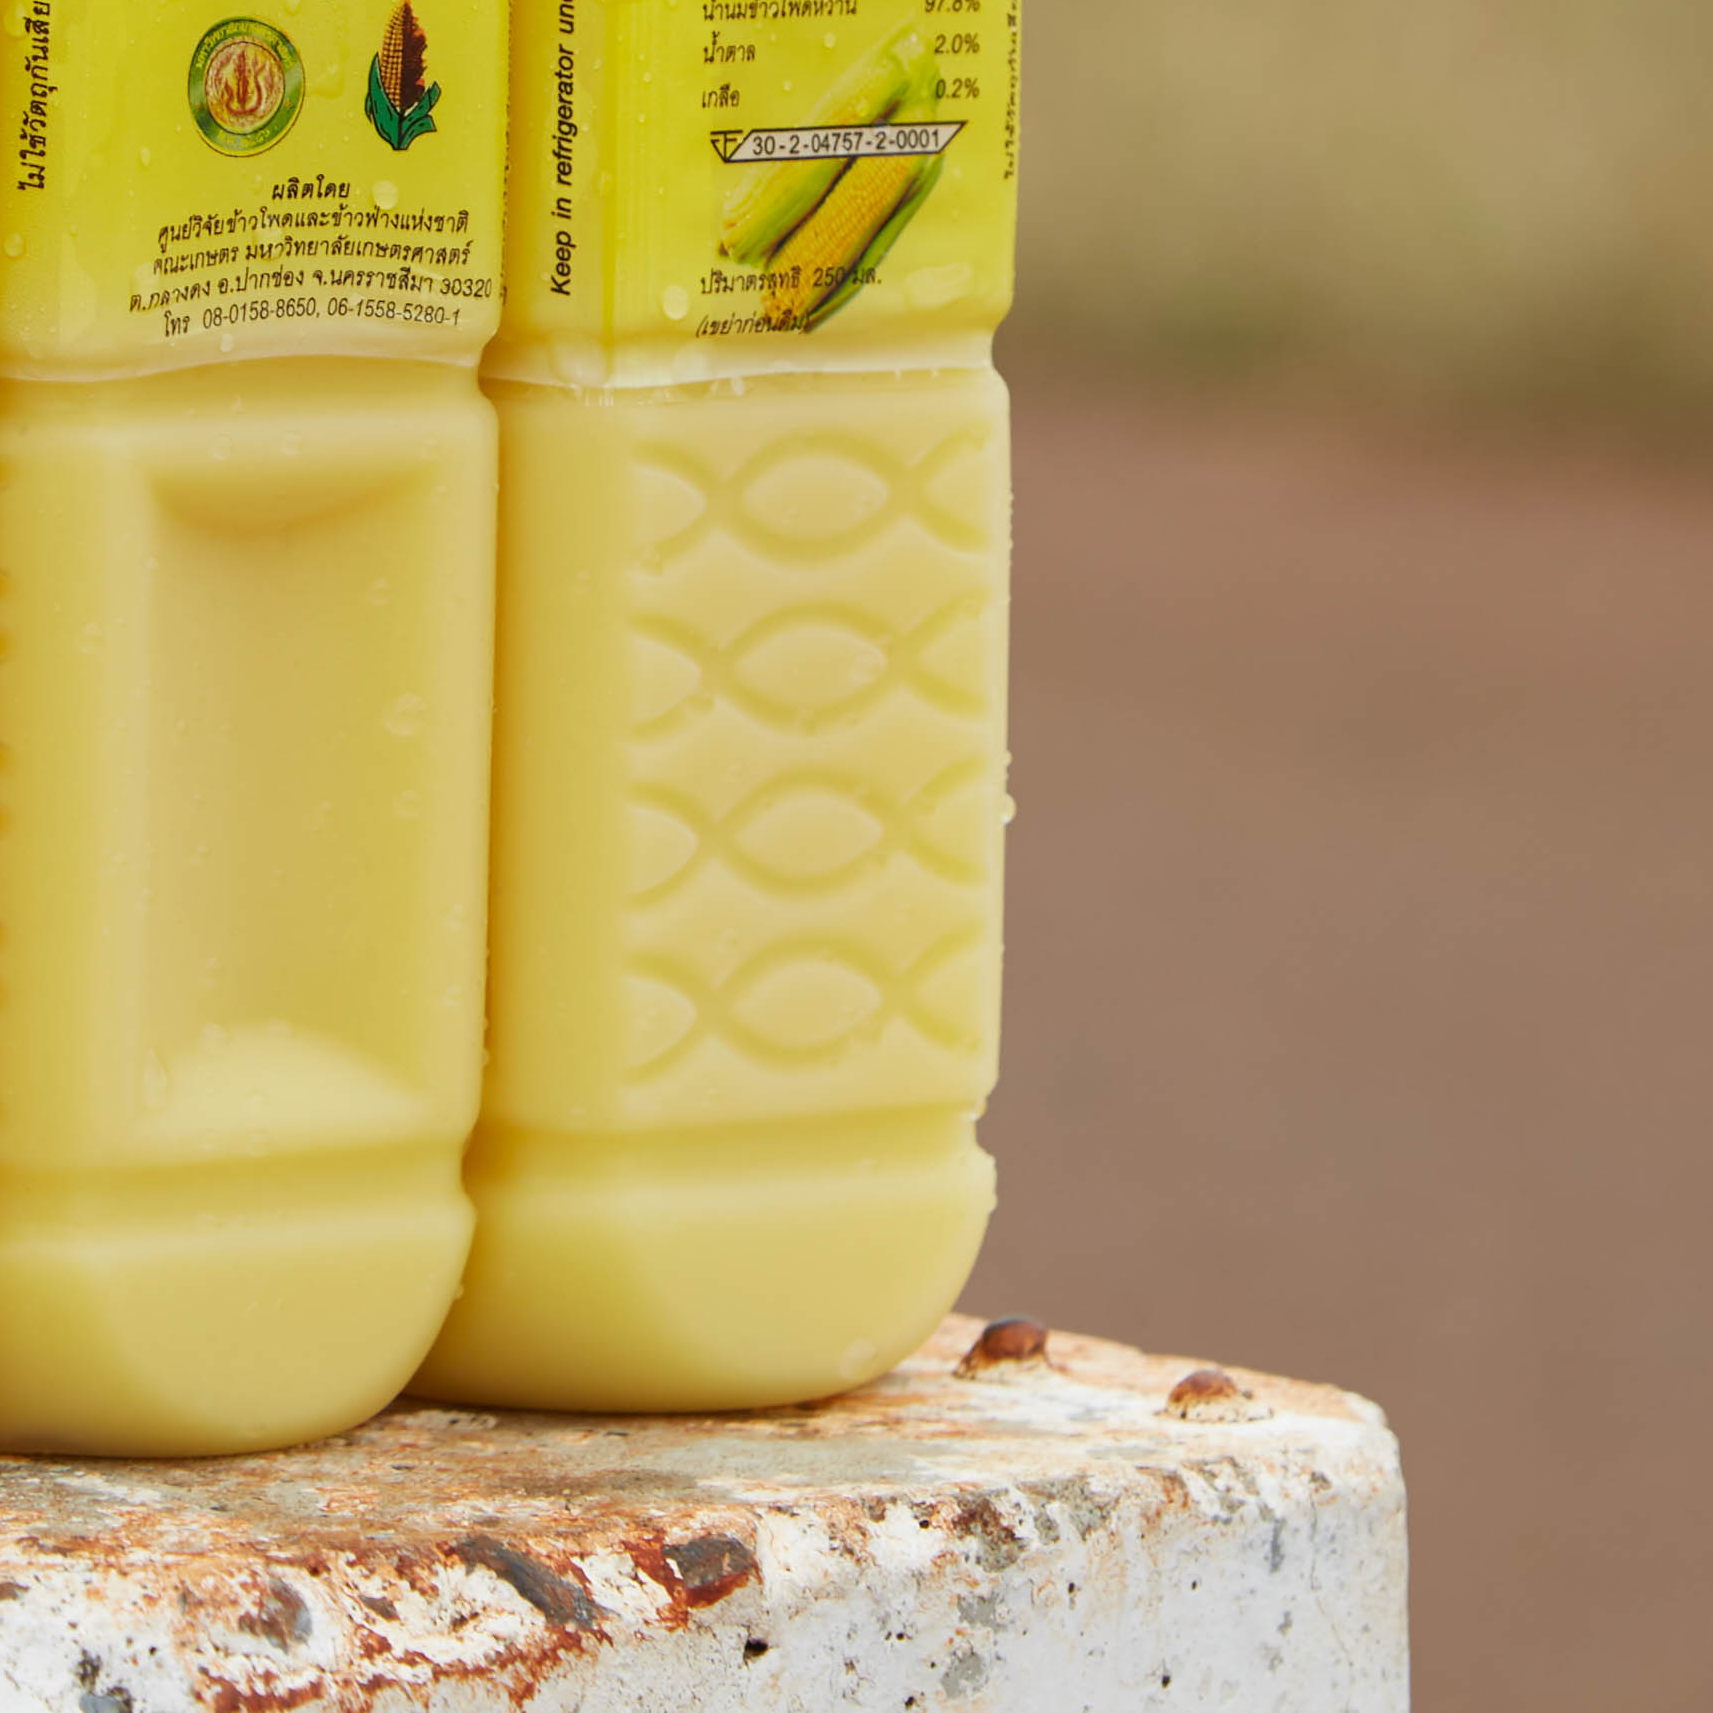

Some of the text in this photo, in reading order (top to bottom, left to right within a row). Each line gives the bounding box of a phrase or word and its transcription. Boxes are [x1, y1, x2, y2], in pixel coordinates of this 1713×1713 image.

[703, 30, 981, 64] น้ำตาล 2.0%
[17, 0, 59, 191] ไม่ใช้วัตถุกันเสีย
[701, 79, 981, 110] เกลือ 0.2%
[552, 43, 579, 187] refrigerator
[271, 173, 351, 201] ผลิตโดย
[550, 195, 573, 221] in
[152, 234, 473, 277] คณะเกษตร มหาวิทยาลัยเกษตรศาสตร์
[551, 231, 577, 297] Keep
[217, 263, 306, 296] อ.ปากช่อง
[312, 266, 435, 295] จ.นครราชสีมา
[439, 276, 494, 300] 30320
[813, 267, 848, 289] 250
[164, 296, 462, 338] โทร 08-0158-8650, 06-1558-5280-1
